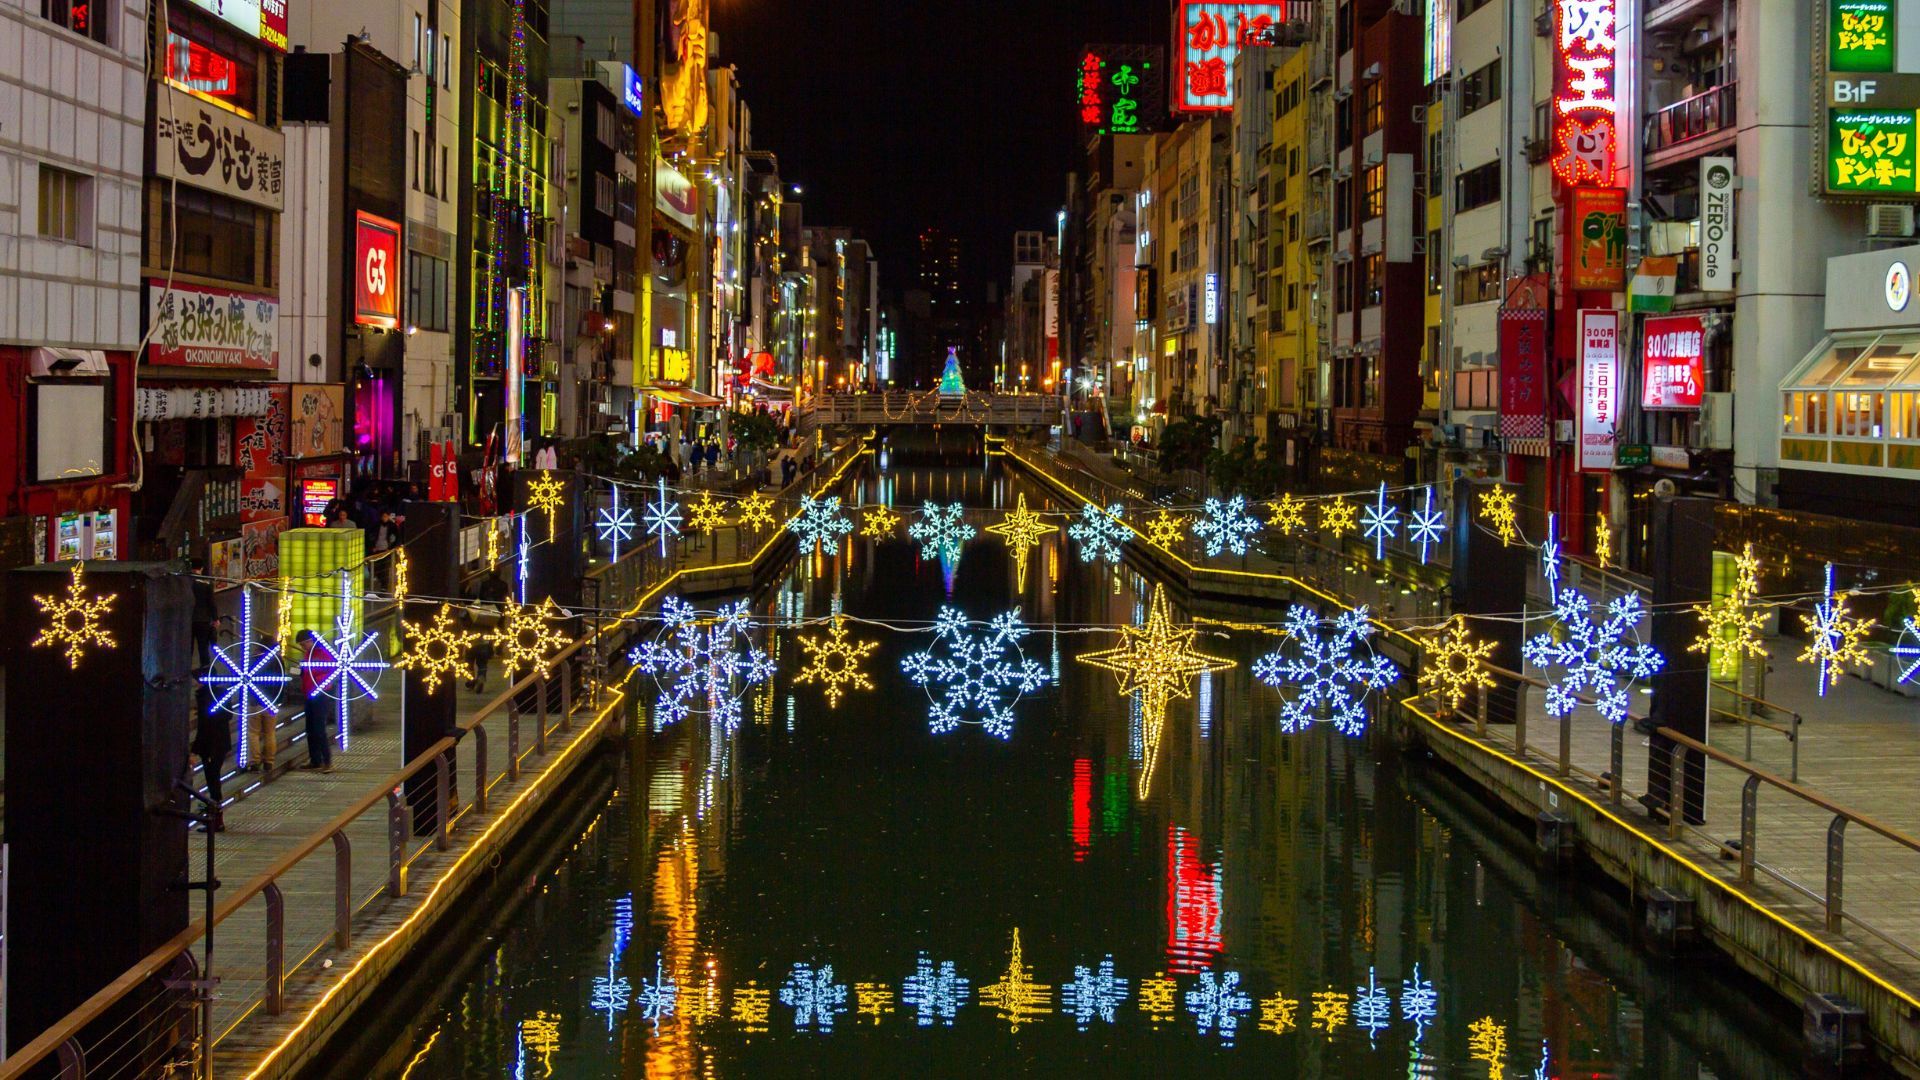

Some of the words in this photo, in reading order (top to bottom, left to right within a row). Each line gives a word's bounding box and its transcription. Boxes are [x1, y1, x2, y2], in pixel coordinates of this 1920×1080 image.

[1841, 12, 1884, 32] びっくり
[1838, 31, 1887, 51] ドンキー
[1834, 80, 1876, 103] B1F
[1836, 115, 1912, 124] ハンバーグレストラン
[178, 109, 255, 190] うなぎ
[1840, 127, 1907, 158] びっくり
[1835, 157, 1911, 186] ドンキー
[1707, 192, 1724, 241] ZERO
[366, 247, 387, 296] G3
[1586, 328, 1614, 338] 300円
[185, 348, 242, 364] OKONOMIYAKI
